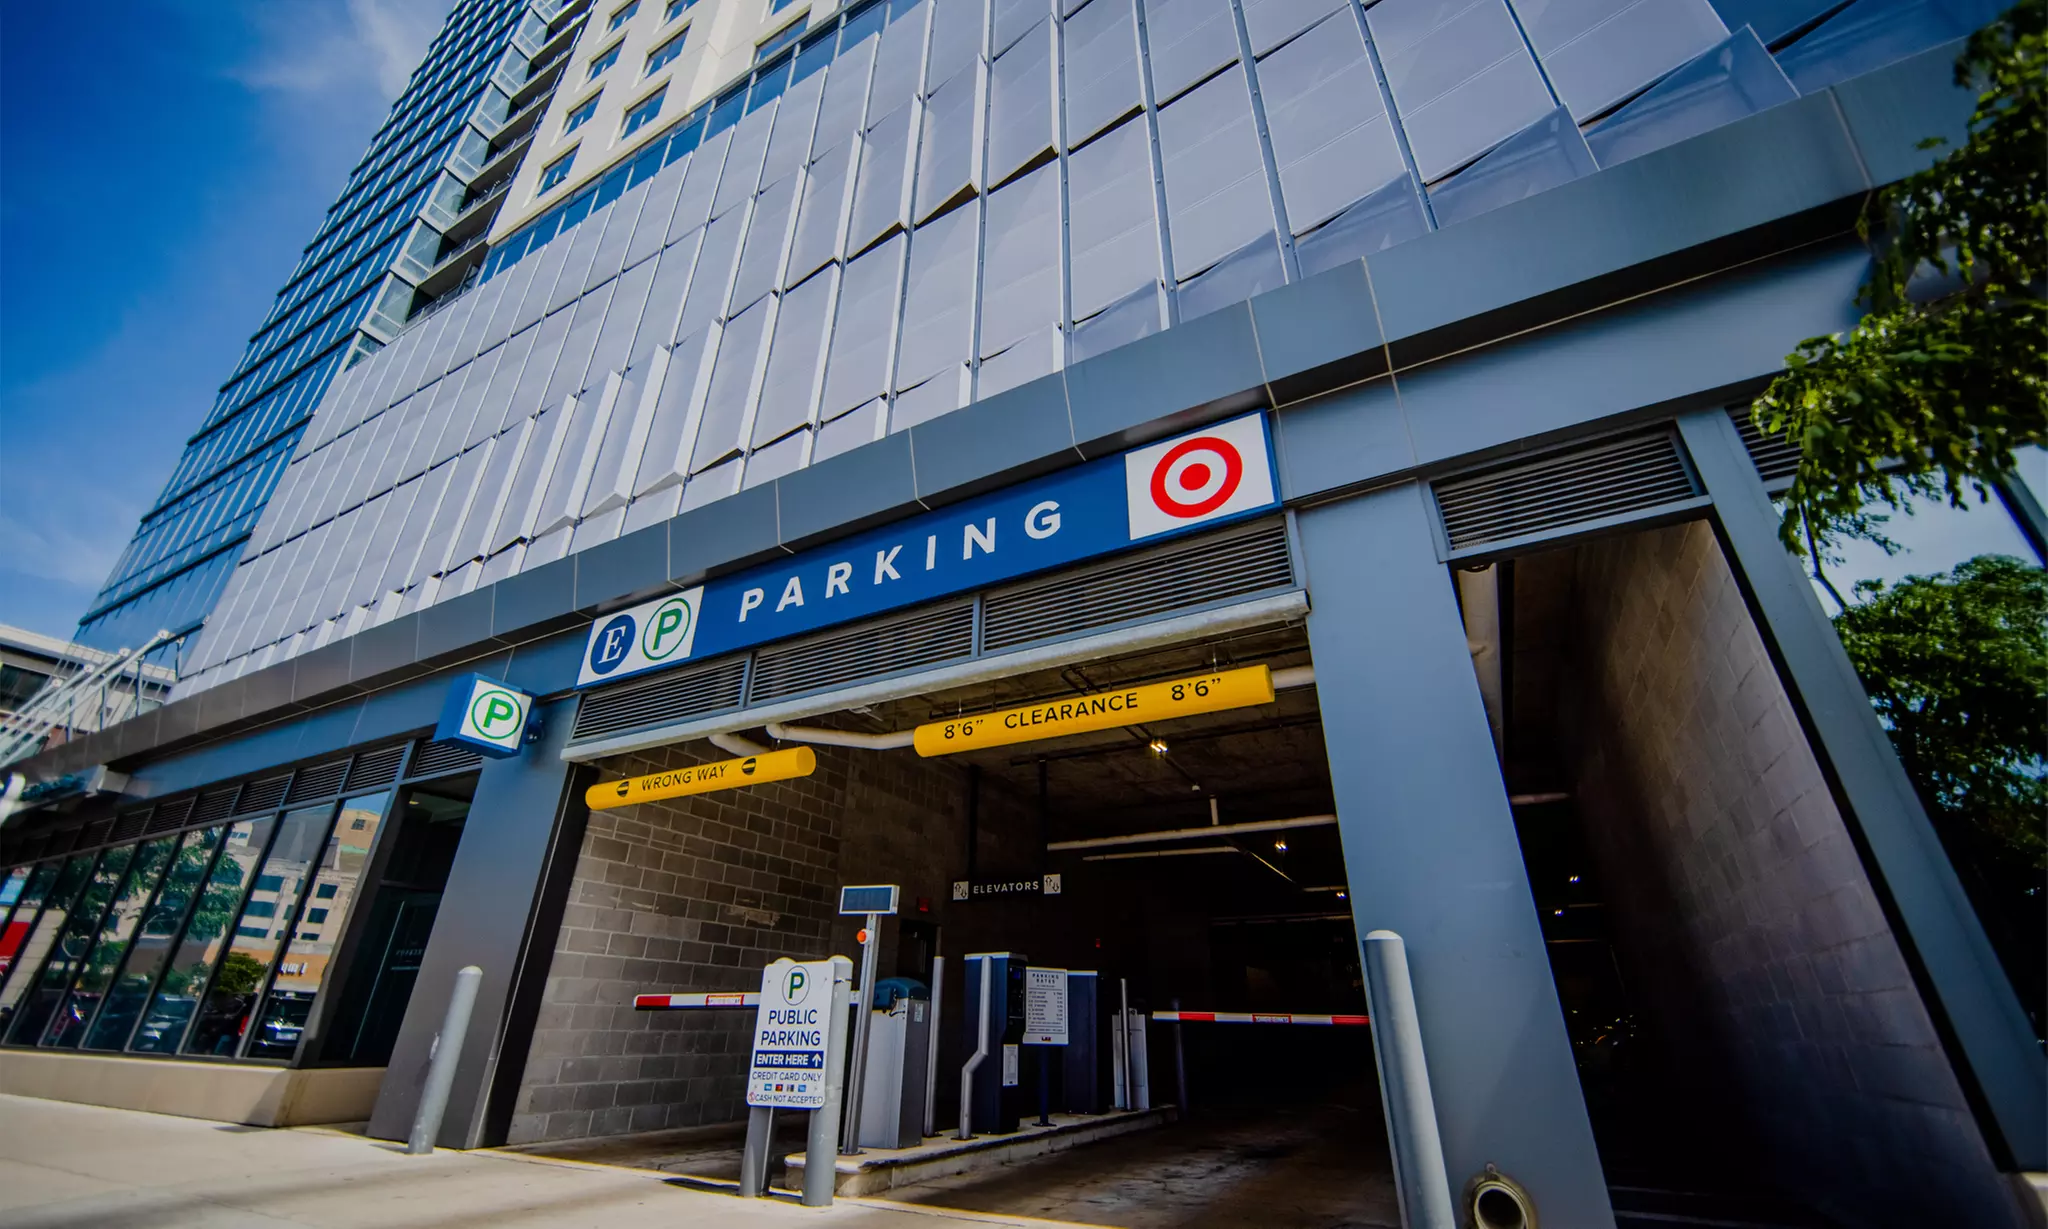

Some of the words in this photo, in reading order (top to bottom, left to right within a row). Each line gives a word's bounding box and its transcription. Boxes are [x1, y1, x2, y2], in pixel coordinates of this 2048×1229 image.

[738, 500, 1062, 623] PARKING
[601, 625, 629, 664] E
[653, 607, 681, 651] P
[482, 697, 514, 729] P
[1004, 692, 1139, 729] CLEARANCE
[641, 770, 693, 793] WRONG
[695, 763, 727, 785] WAY
[973, 881, 1039, 894] ELEVATORS
[788, 972, 805, 1000] P
[768, 1009, 818, 1025] PUBLIC
[760, 1030, 821, 1047] PARKING
[756, 1054, 784, 1065] ENTER
[785, 1054, 808, 1065] HERE
[752, 1071, 778, 1081] CREDIT
[779, 1071, 801, 1082] CARD
[801, 1072, 822, 1082] ONLY
[755, 1094, 772, 1102] CASH
[773, 1094, 787, 1103] NOT
[787, 1094, 823, 1104] ACCEPTED
